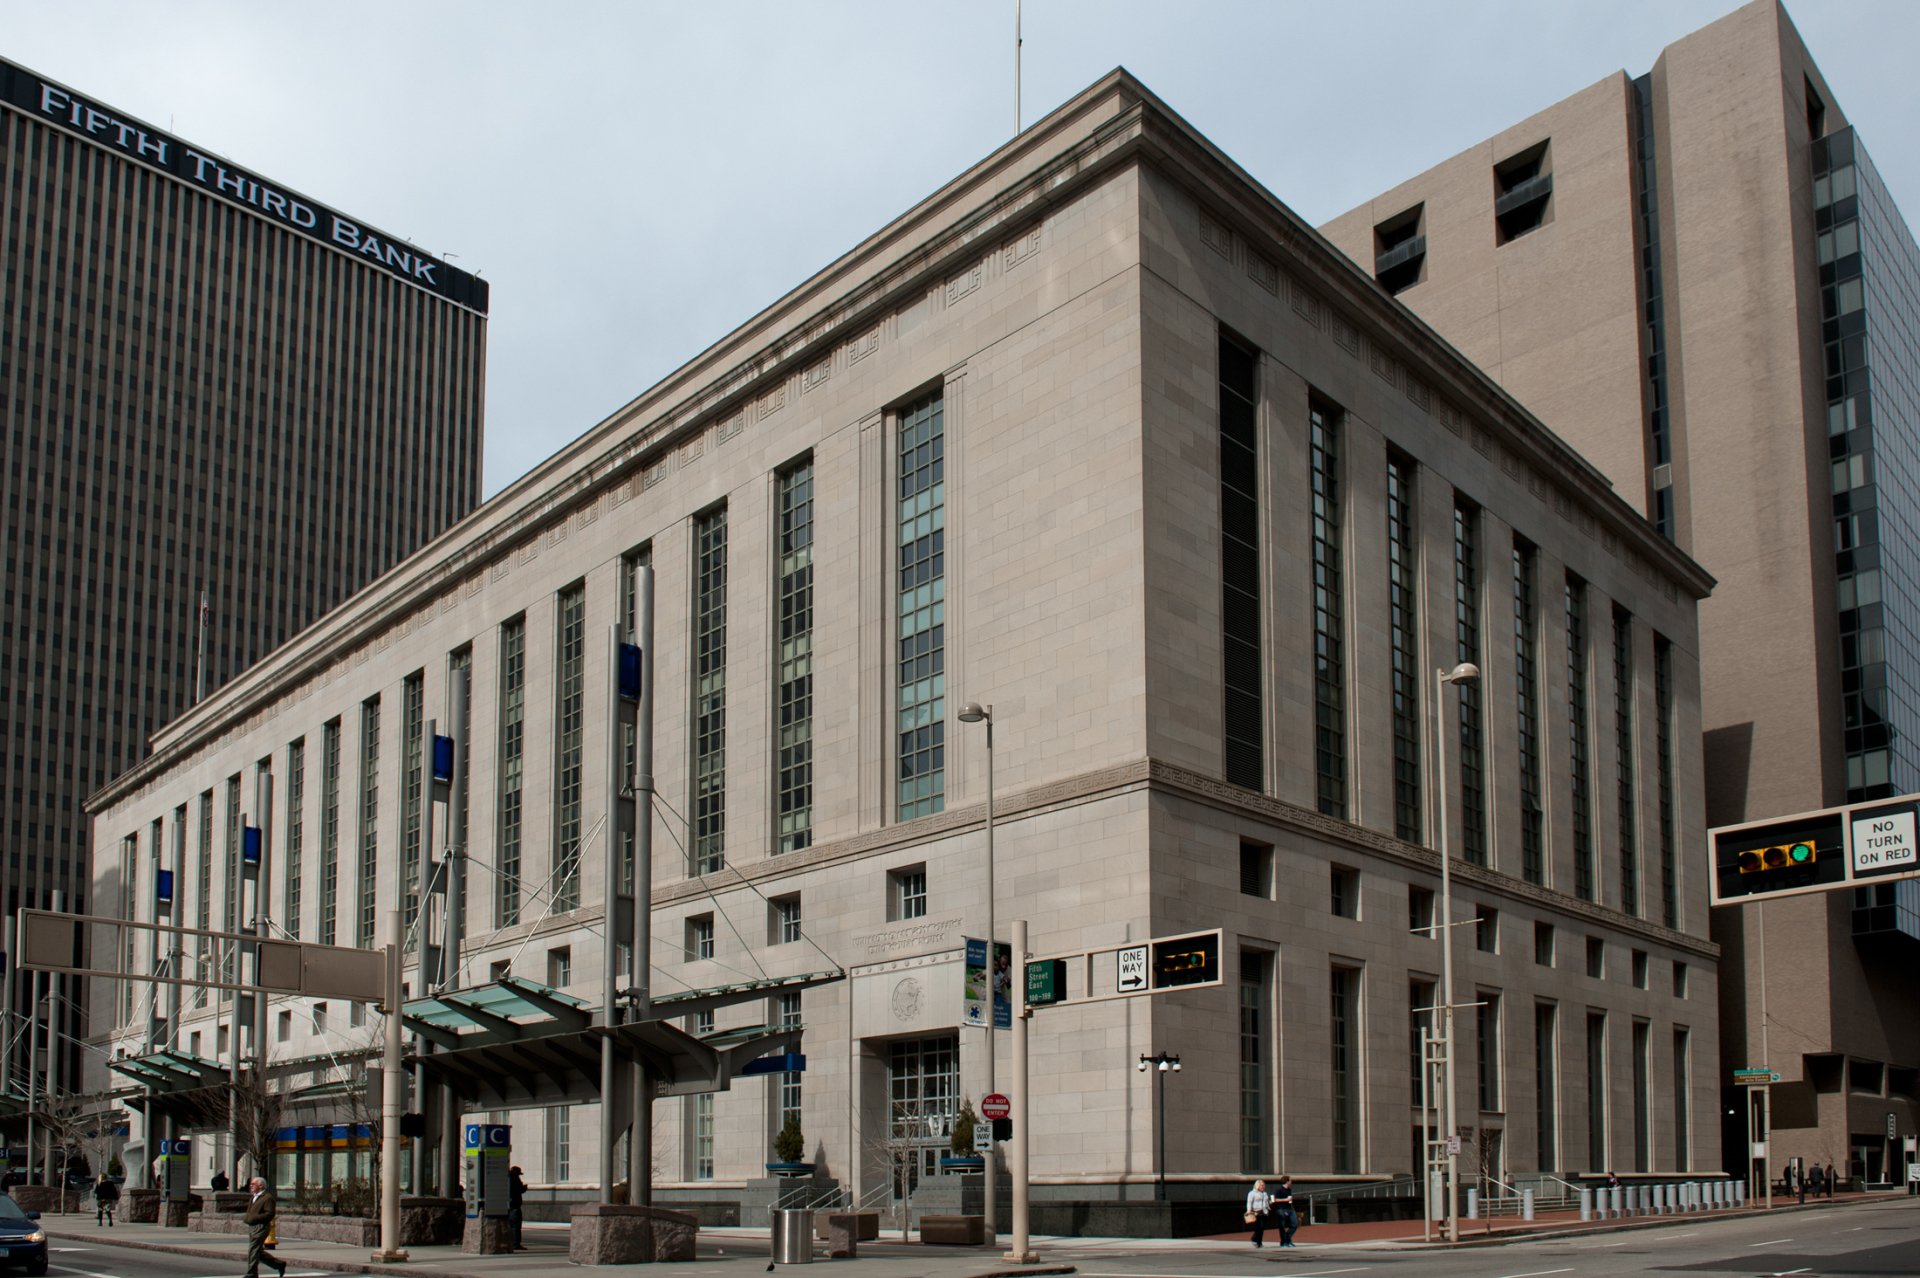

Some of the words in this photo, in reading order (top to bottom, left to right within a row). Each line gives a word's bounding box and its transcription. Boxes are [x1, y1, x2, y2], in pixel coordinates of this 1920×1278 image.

[40, 82, 168, 165] FIFTH
[186, 149, 317, 229] THIRD
[331, 215, 437, 286] BANK
[1872, 820, 1894, 834] NO
[1866, 834, 1903, 849] TURN
[1860, 852, 1879, 865] ON
[1885, 847, 1911, 861] RED
[1122, 950, 1143, 963] ONE
[1028, 964, 1042, 973] Fifth
[1122, 962, 1143, 974] WAY
[1028, 972, 1049, 981] Street
[1028, 981, 1043, 990] East
[468, 1127, 477, 1144] C
[490, 1127, 504, 1144] C
[174, 1141, 186, 1153] C
